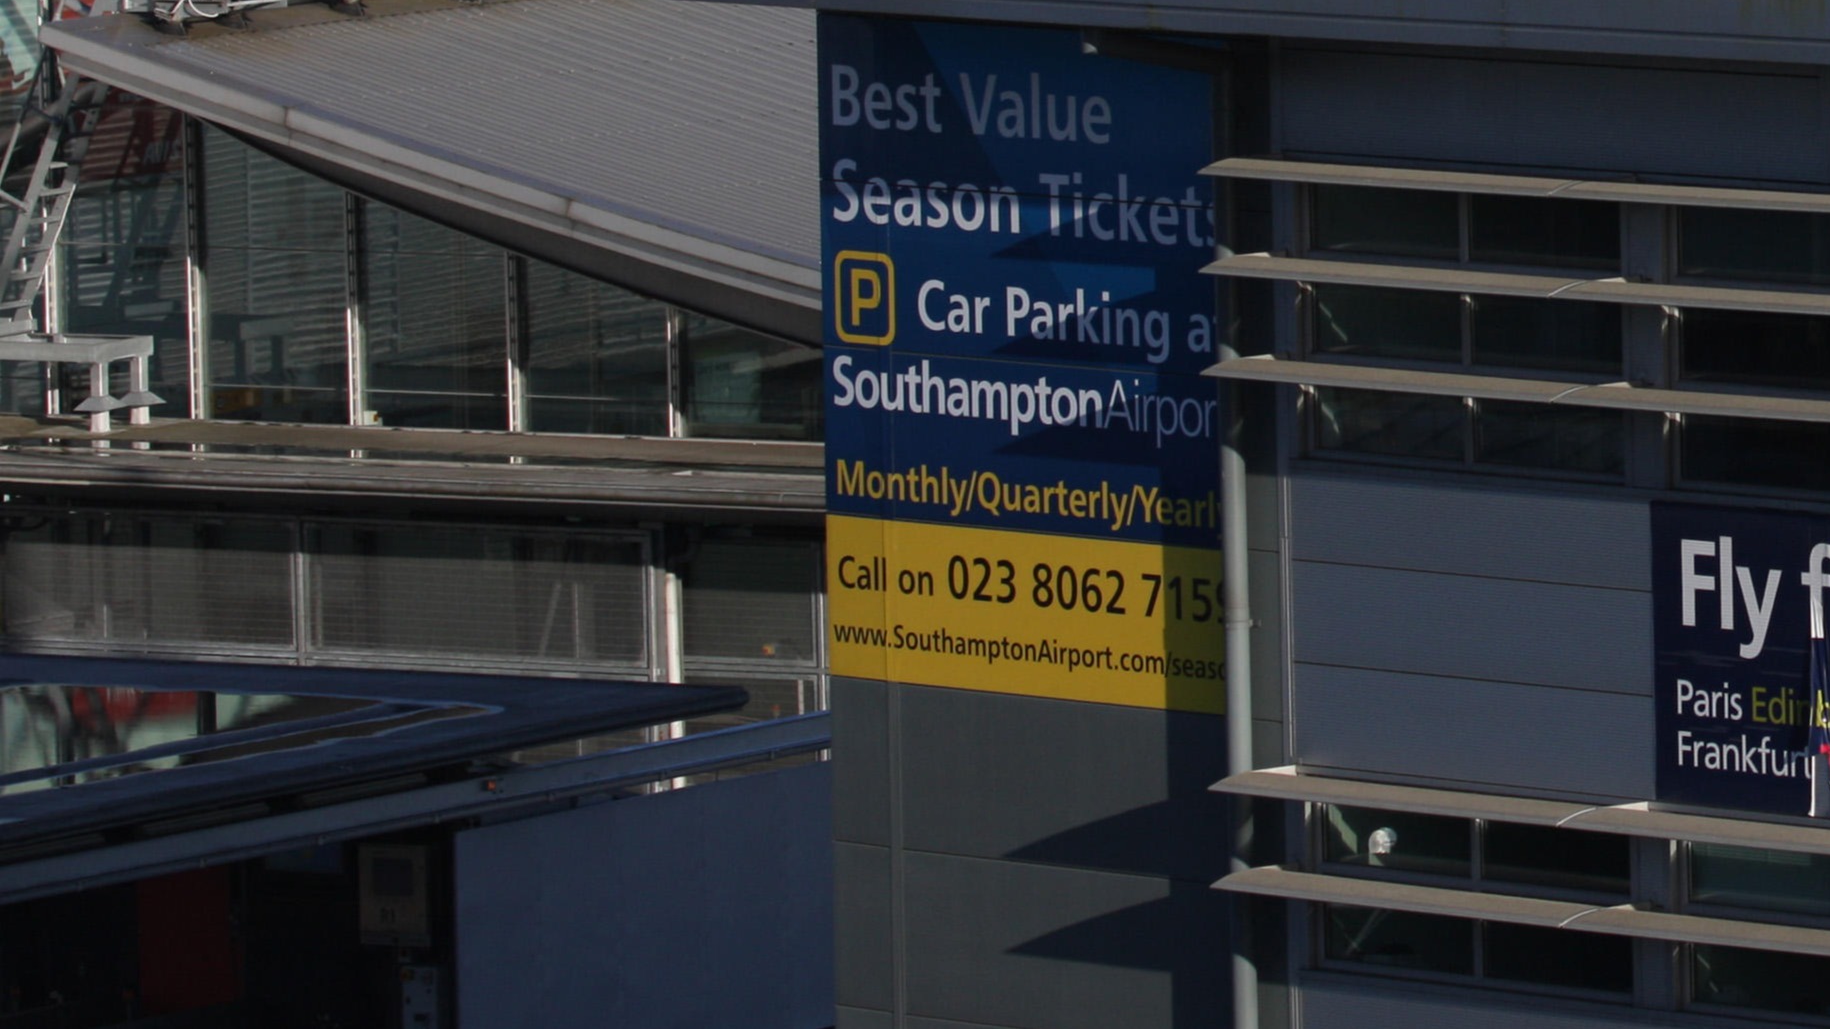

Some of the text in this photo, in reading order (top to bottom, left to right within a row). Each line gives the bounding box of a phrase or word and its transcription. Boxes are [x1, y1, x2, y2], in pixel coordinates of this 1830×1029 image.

[831, 65, 1112, 144] Best Value
[832, 158, 1020, 234] Season
[917, 280, 1216, 364] Car Parking a
[838, 555, 887, 593] Call
[898, 568, 934, 597] on
[948, 554, 1017, 604] 023
[1032, 563, 1126, 616] 8062
[1680, 535, 1783, 660] Fly
[1676, 678, 1743, 721] Paris
[1677, 731, 1814, 780] Frankfurt
